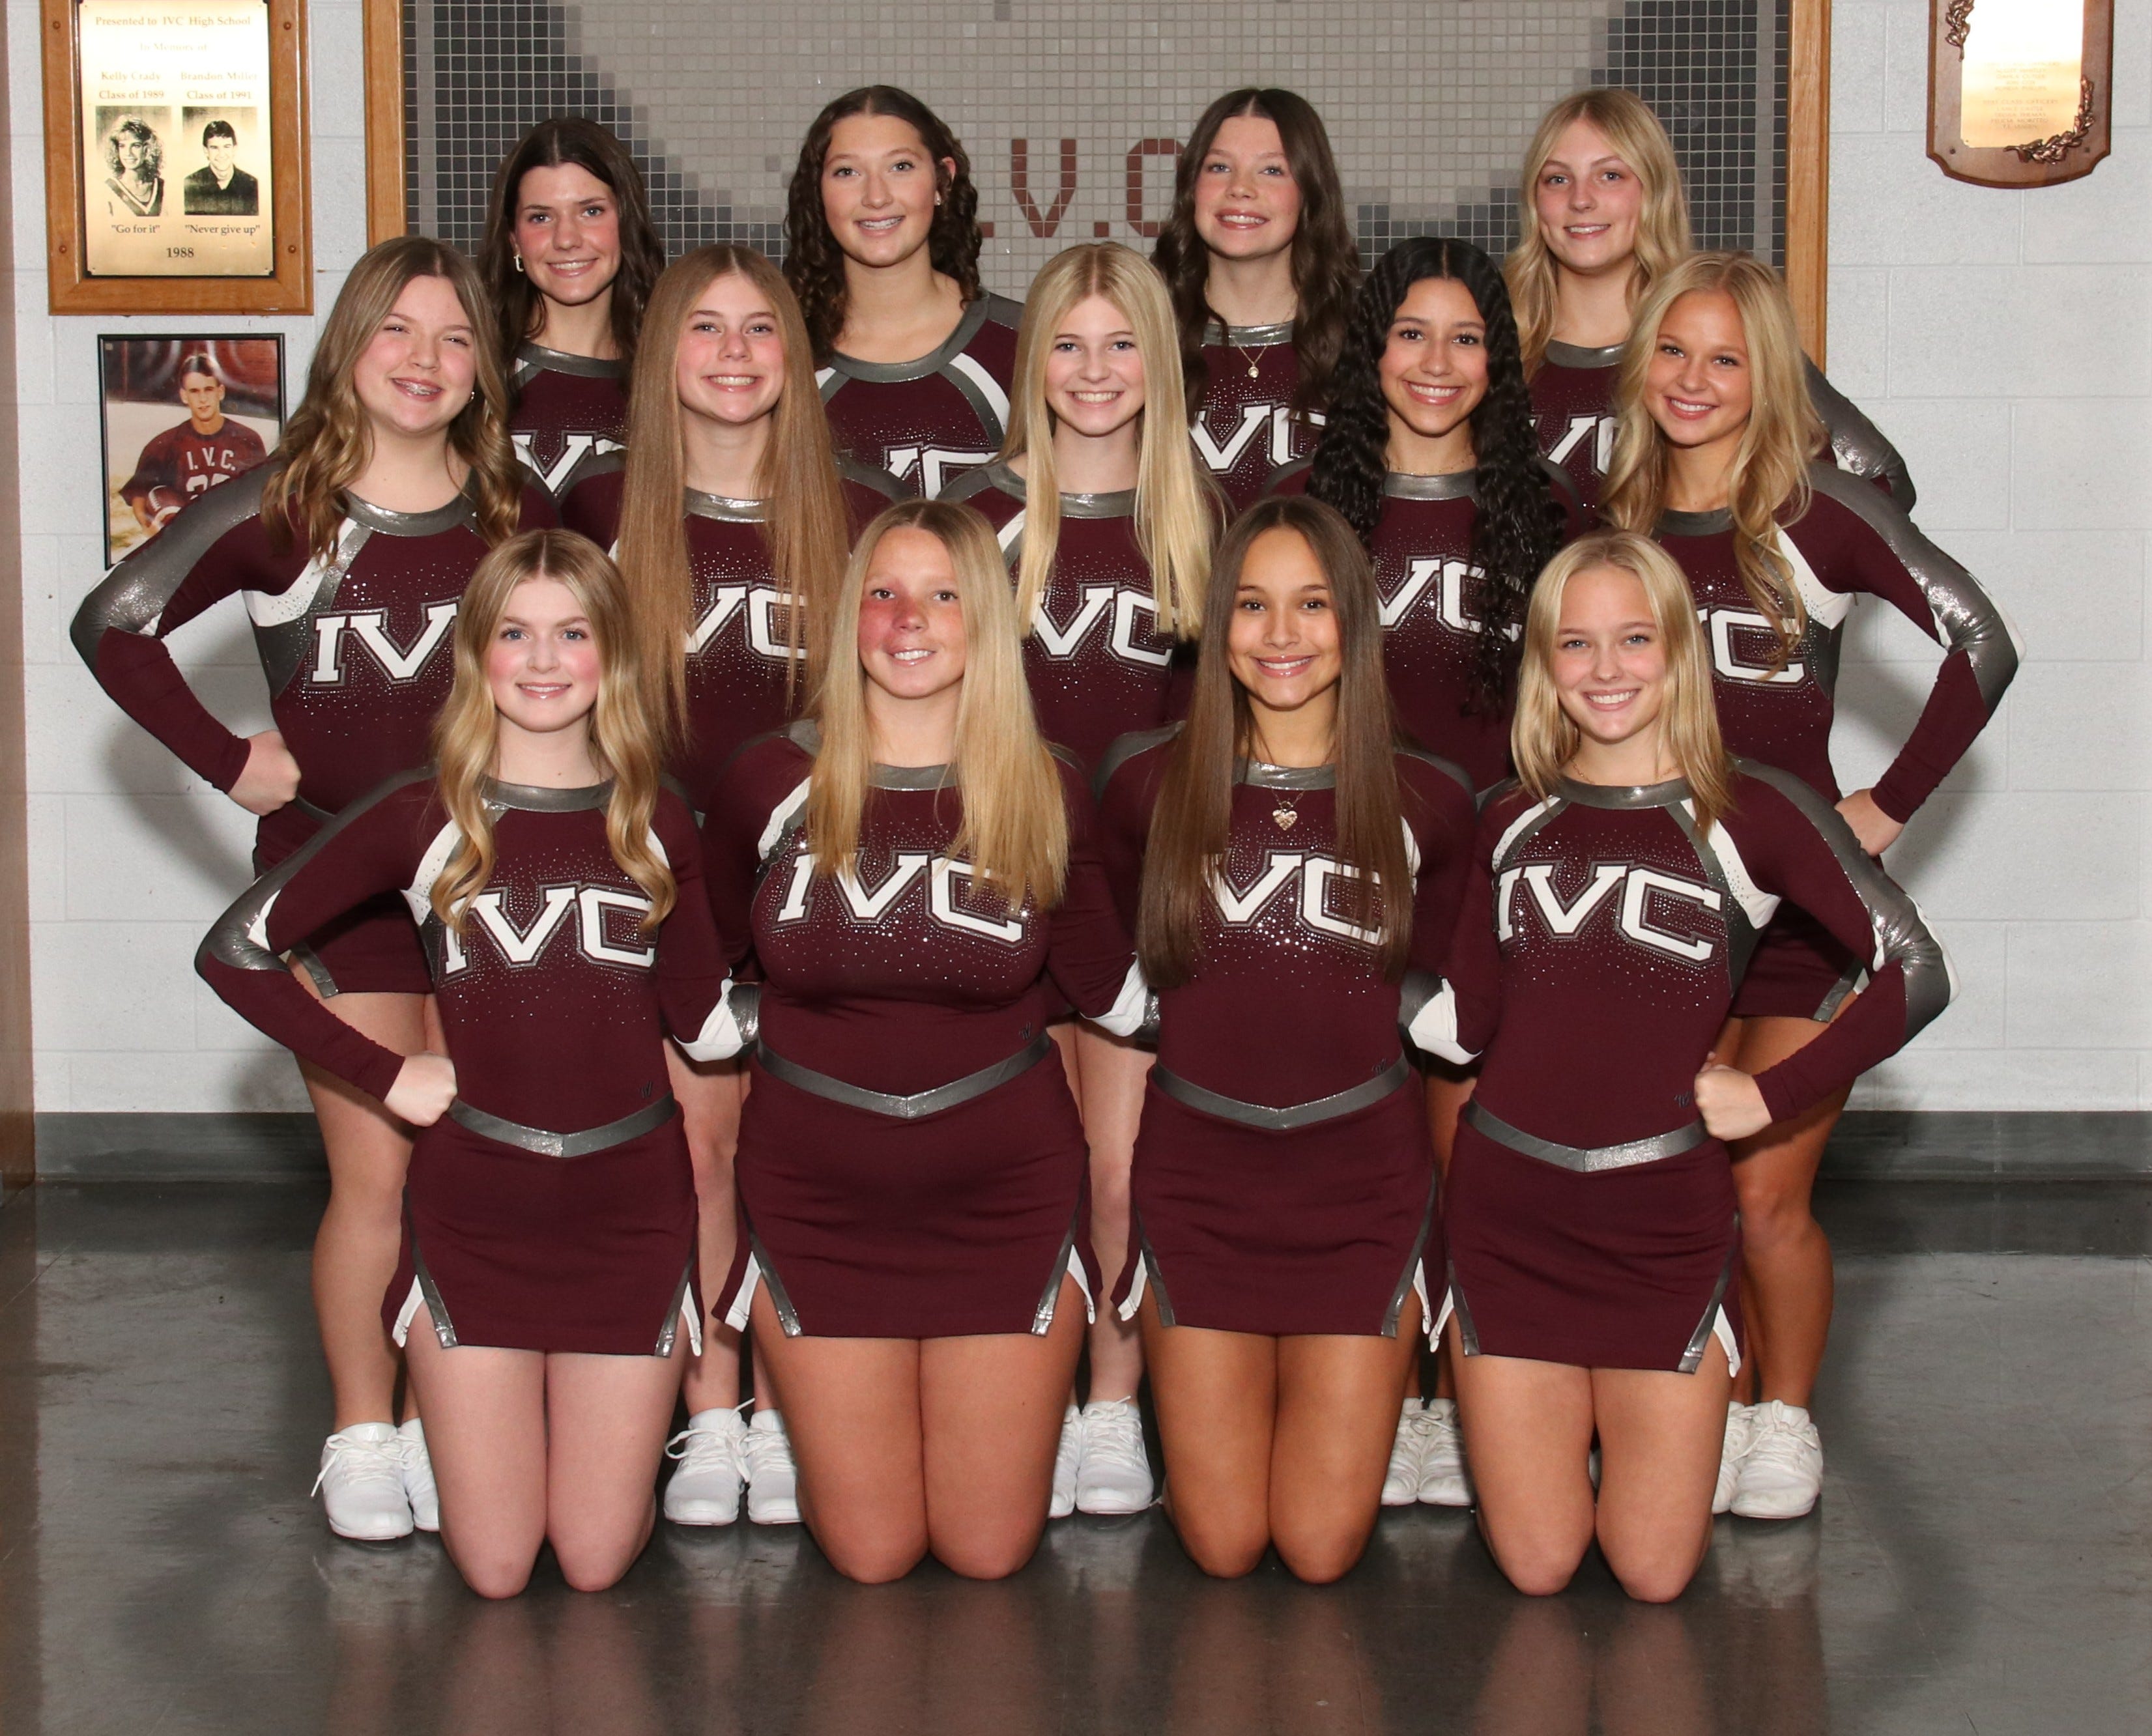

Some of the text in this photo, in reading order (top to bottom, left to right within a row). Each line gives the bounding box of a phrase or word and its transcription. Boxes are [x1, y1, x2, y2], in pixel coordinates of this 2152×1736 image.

[96, 16, 144, 25] Presented
[163, 17, 183, 25] IVC
[189, 16, 214, 28] High
[218, 16, 251, 25] School
[198, 42, 207, 51] of
[99, 91, 164, 99] Class of 1989
[101, 72, 127, 82] Kelly
[181, 72, 257, 80] Brandon Miller
[186, 91, 251, 100] Class of 1991
[111, 225, 160, 234] "Go for it"
[185, 225, 261, 236] "Never give up"
[167, 248, 194, 258] 1988
[1189, 405, 1325, 470] VC
[1377, 560, 1523, 642] VC
[683, 586, 808, 659] VC
[1034, 587, 1175, 666] VC
[312, 603, 457, 683] IV
[777, 853, 1023, 943] IVC
[1201, 854, 1386, 946] VC
[1499, 865, 1721, 961] IVC
[446, 887, 655, 974] IVC
